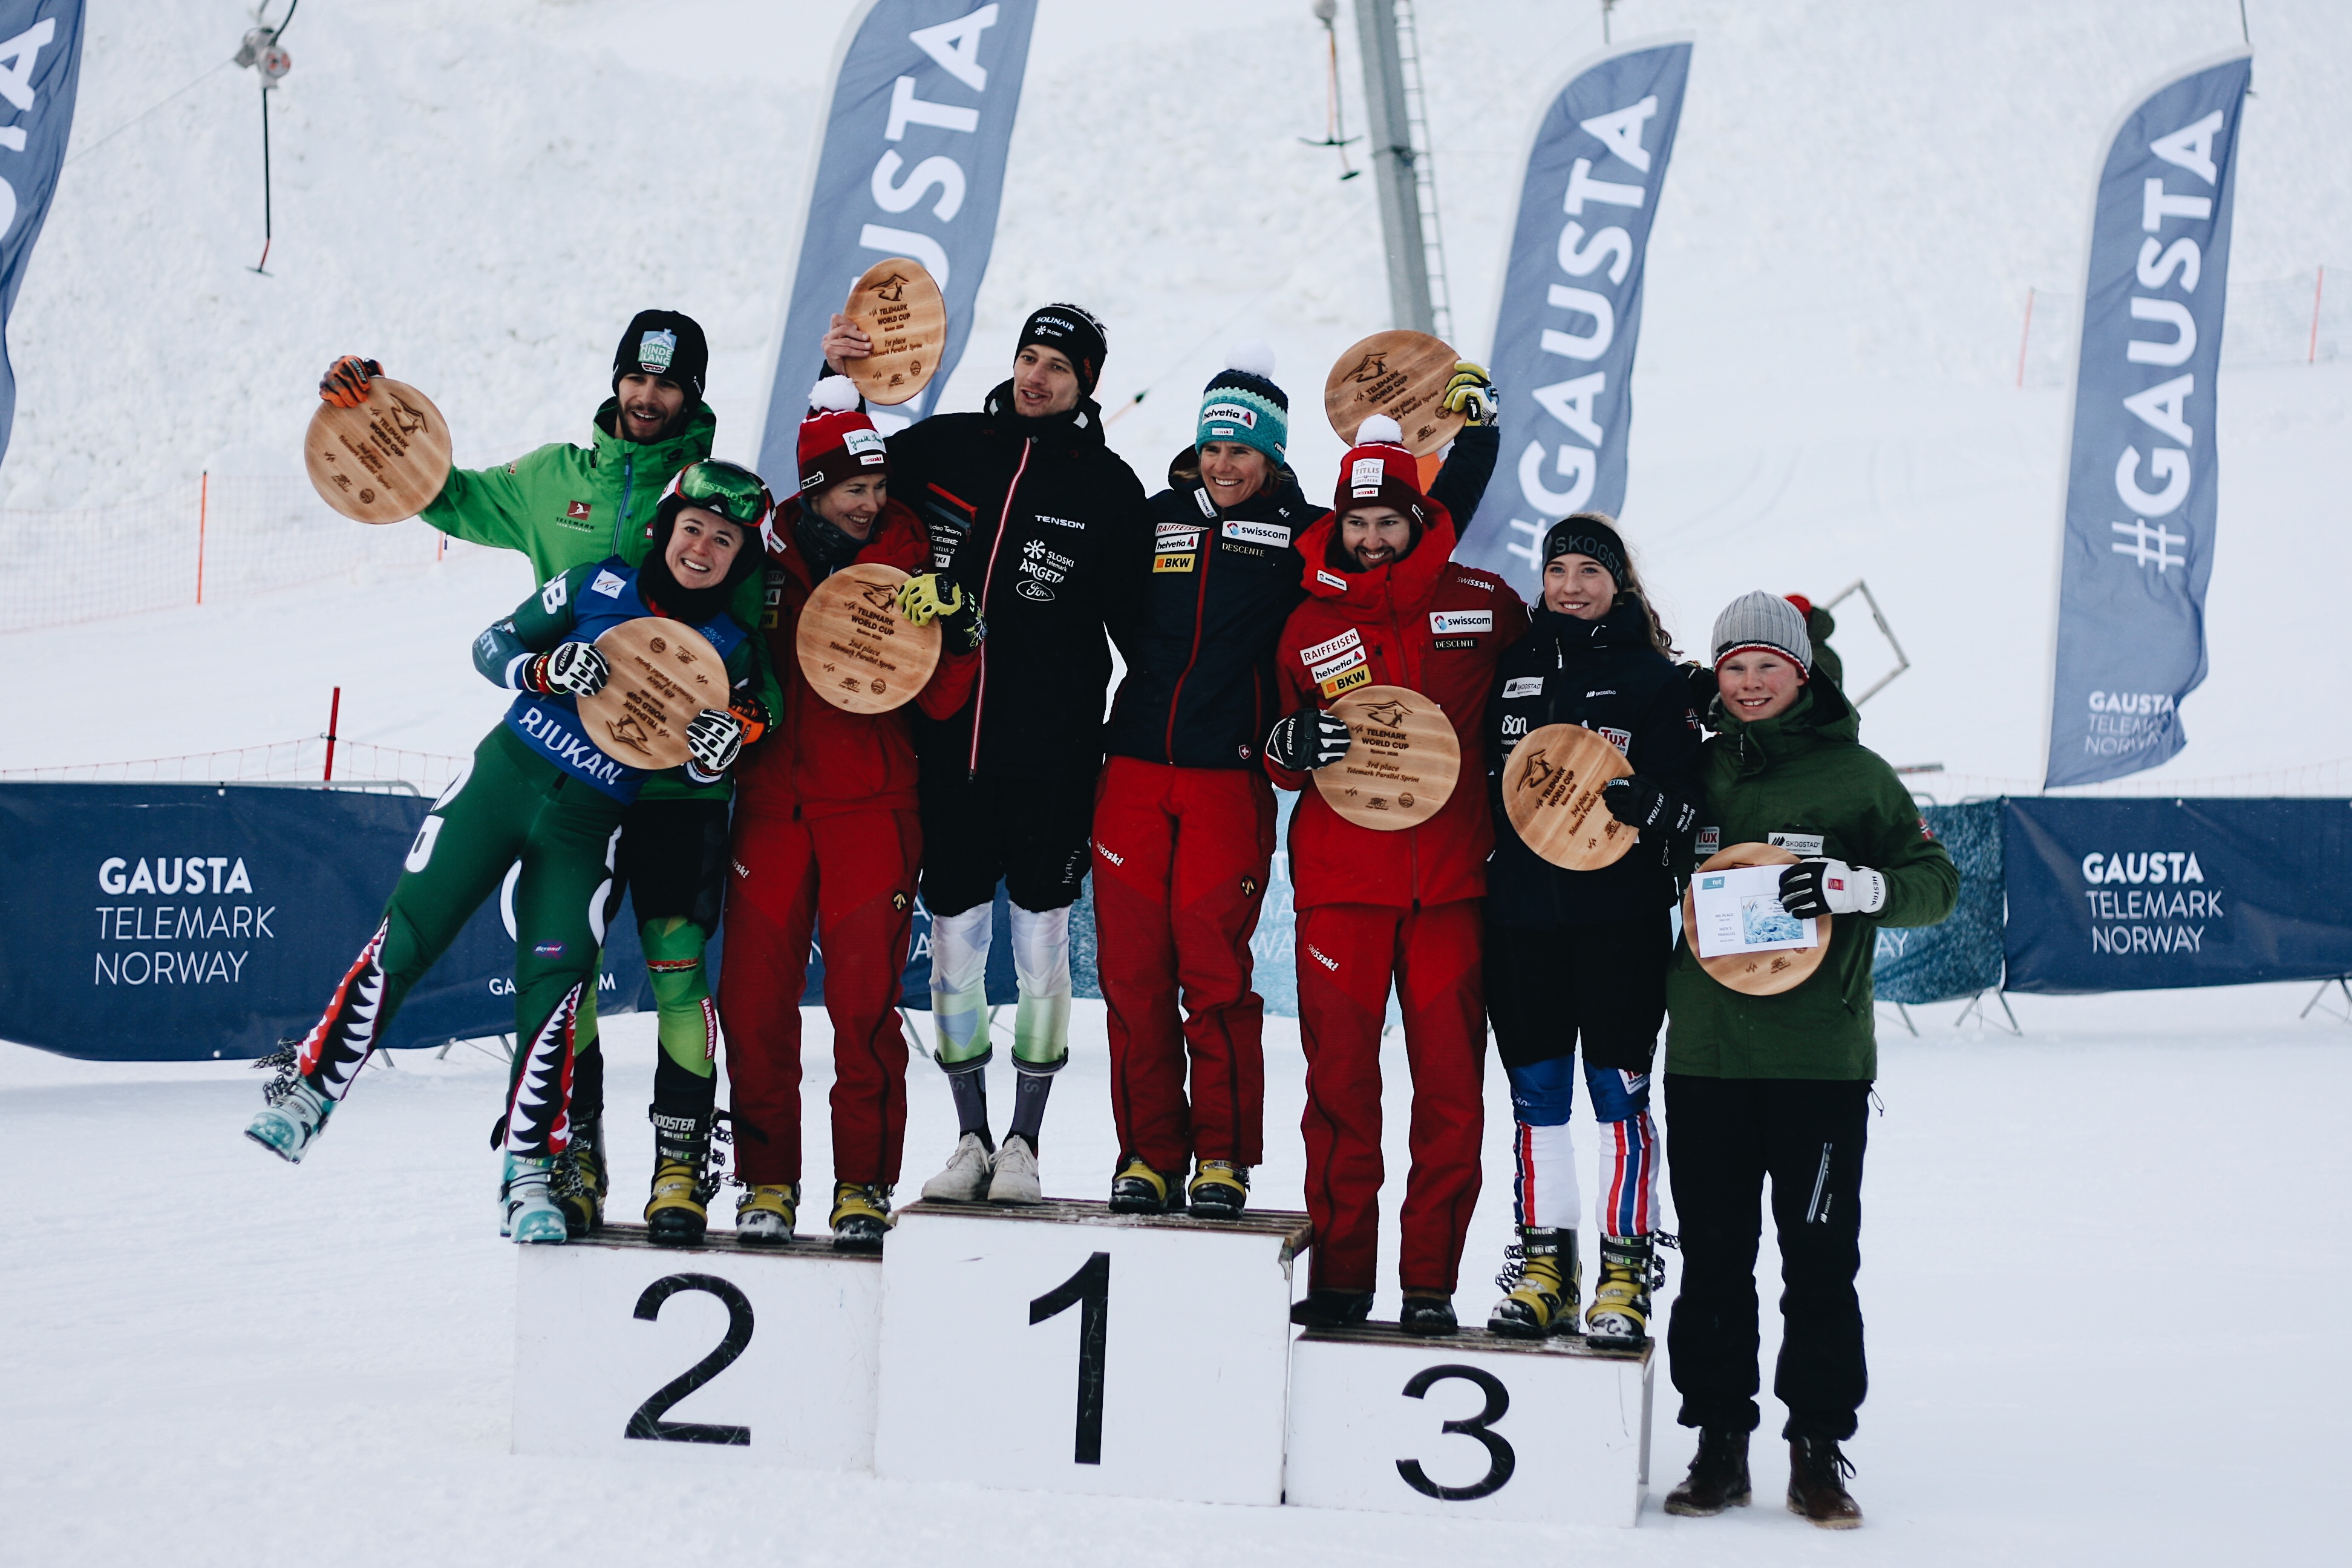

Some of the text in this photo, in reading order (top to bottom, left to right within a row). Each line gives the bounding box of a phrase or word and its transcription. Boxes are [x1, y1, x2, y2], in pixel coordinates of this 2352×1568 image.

[879, 304, 908, 315] TELEMARK
[877, 316, 897, 325] WORLD
[1035, 316, 1075, 332] SOLINAIR
[891, 336, 906, 347] place
[1506, 94, 1658, 569] #GAUSTA
[2111, 109, 2225, 573] #GAUSTA
[644, 353, 670, 366] LANG
[1365, 370, 1401, 396] TELEMARK
[1368, 374, 1409, 404] WORLD CUP
[1398, 395, 1417, 411] place
[1203, 409, 1240, 420] helvetia
[368, 422, 405, 459] WORLD CUP
[377, 417, 409, 449] TELEMARK
[364, 451, 384, 471] place
[555, 517, 596, 530] TELEMARK
[1035, 515, 1085, 530] TENSON
[1156, 524, 1205, 534] RAIFFEISEN
[1241, 526, 1288, 541] swisscom
[1157, 539, 1186, 550] helvetia
[1222, 543, 1266, 557] DESCENTE
[1046, 558, 1067, 572] Telemark
[1047, 550, 1074, 567] SLOSKI
[1165, 558, 1191, 567] BKW
[1555, 535, 1623, 586] SKOGSTA
[850, 615, 895, 636] WORLD CUP
[856, 607, 895, 626] TELEMARK
[1447, 616, 1491, 626] swisscom
[861, 644, 881, 657] place
[1303, 632, 1357, 662] RAIFFEISEN
[1436, 639, 1475, 648] DESCENTE
[558, 642, 575, 671] reusch
[1315, 658, 1352, 680] helvetia
[646, 673, 667, 692] place
[1336, 670, 1366, 690] BKW
[626, 690, 667, 724] WORLD CUP
[2088, 690, 2175, 716] GAUSTA
[622, 699, 658, 730] TELEMARK
[1286, 718, 1296, 756] reusch
[1361, 737, 1409, 750] WORLD CUP
[1367, 728, 1406, 740] TELEMARK
[518, 707, 623, 785] RJUKAN
[1379, 763, 1399, 773] place
[1541, 766, 1567, 799] TELEMARK
[1547, 769, 1576, 808] WORLD CUP
[1576, 789, 1593, 808] place
[1646, 806, 1661, 826] TEAM
[99, 857, 253, 895] GAUSTA
[2082, 851, 2204, 884] GAUSTA
[1870, 875, 1880, 906] HESTRA
[2085, 890, 2224, 920] TELEMARK
[96, 906, 276, 940] TELEMARK
[2091, 924, 2206, 955] NORWAY
[95, 950, 249, 985] NORWAY
[1308, 944, 1339, 972] swissski
[653, 1112, 696, 1131] BOOSTER
[624, 1272, 754, 1446] 2
[1028, 1252, 1110, 1466] 1
[1395, 1363, 1515, 1502] 3
